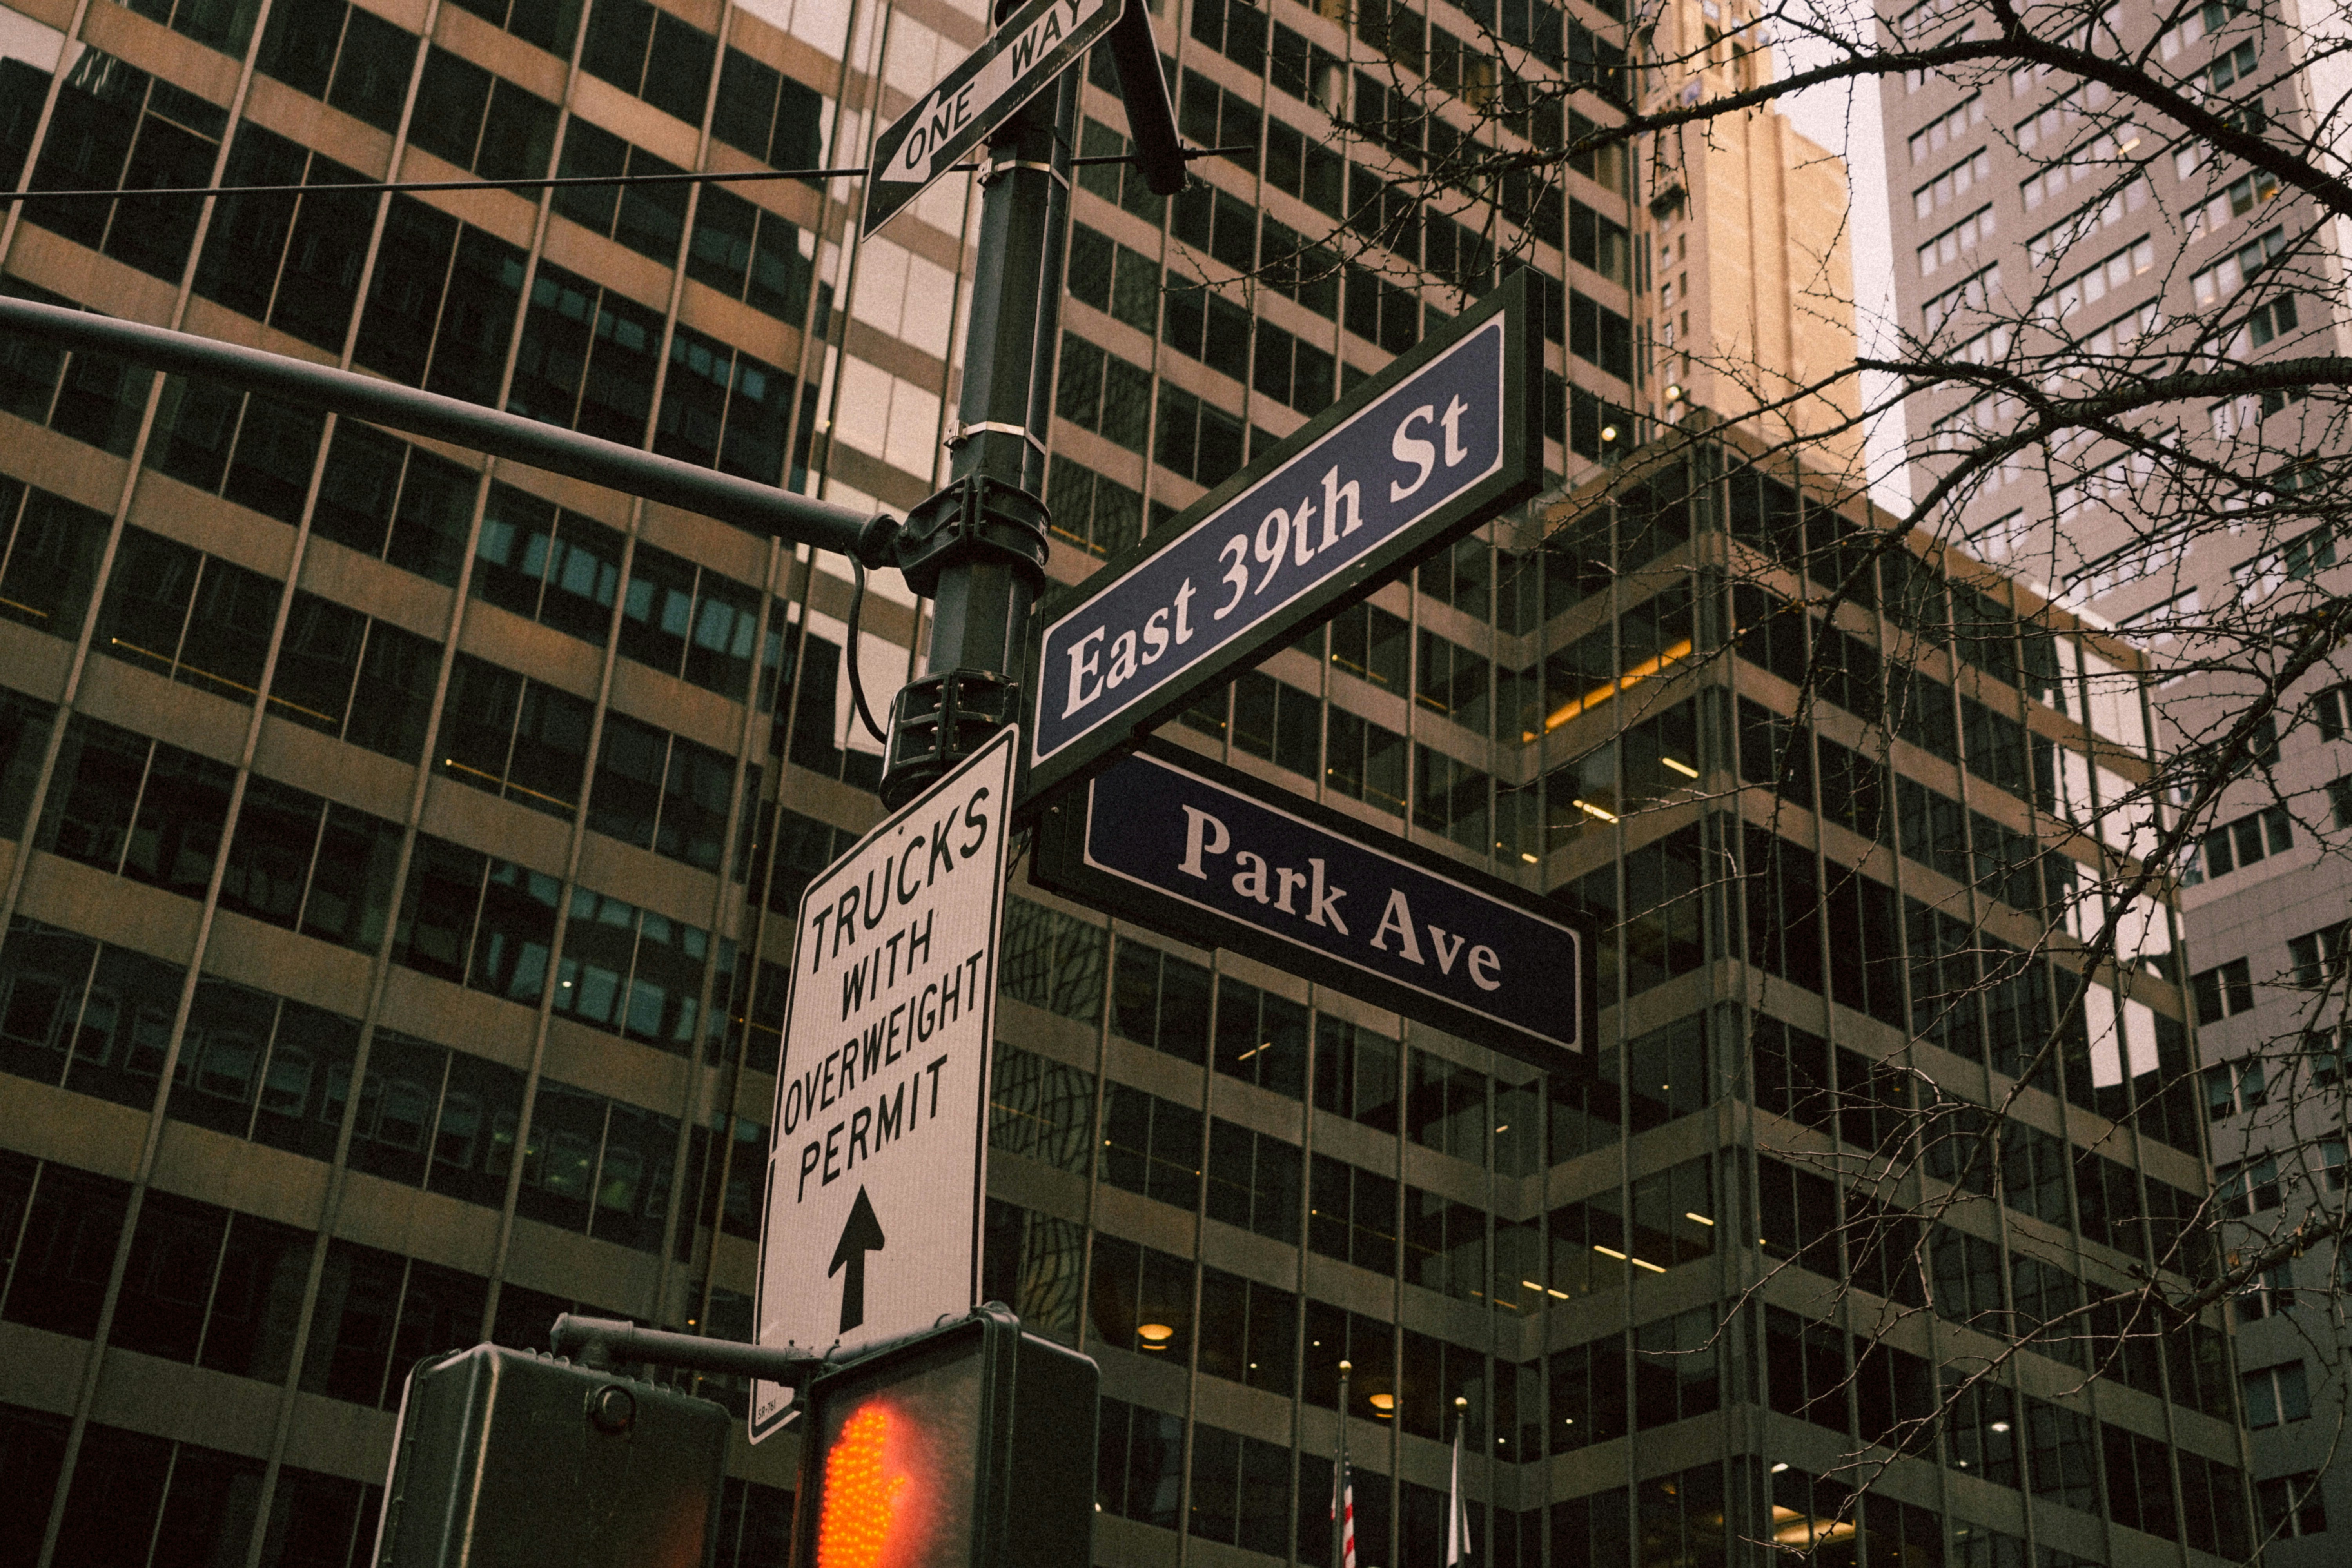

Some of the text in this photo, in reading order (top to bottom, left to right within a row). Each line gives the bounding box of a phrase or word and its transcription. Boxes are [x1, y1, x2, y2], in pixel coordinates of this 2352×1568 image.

[906, 0, 1081, 170] ONE WAY
[1008, 19, 1109, 110] DEPT OF TRANSPORTATION
[1061, 393, 1468, 720] East 39th St
[812, 787, 989, 975] TRUCKS
[842, 908, 933, 1022] WITH
[1178, 804, 1501, 991] Park Ave
[784, 949, 984, 1136] OVERWEIGHT
[797, 1053, 947, 1204] PERMIT
